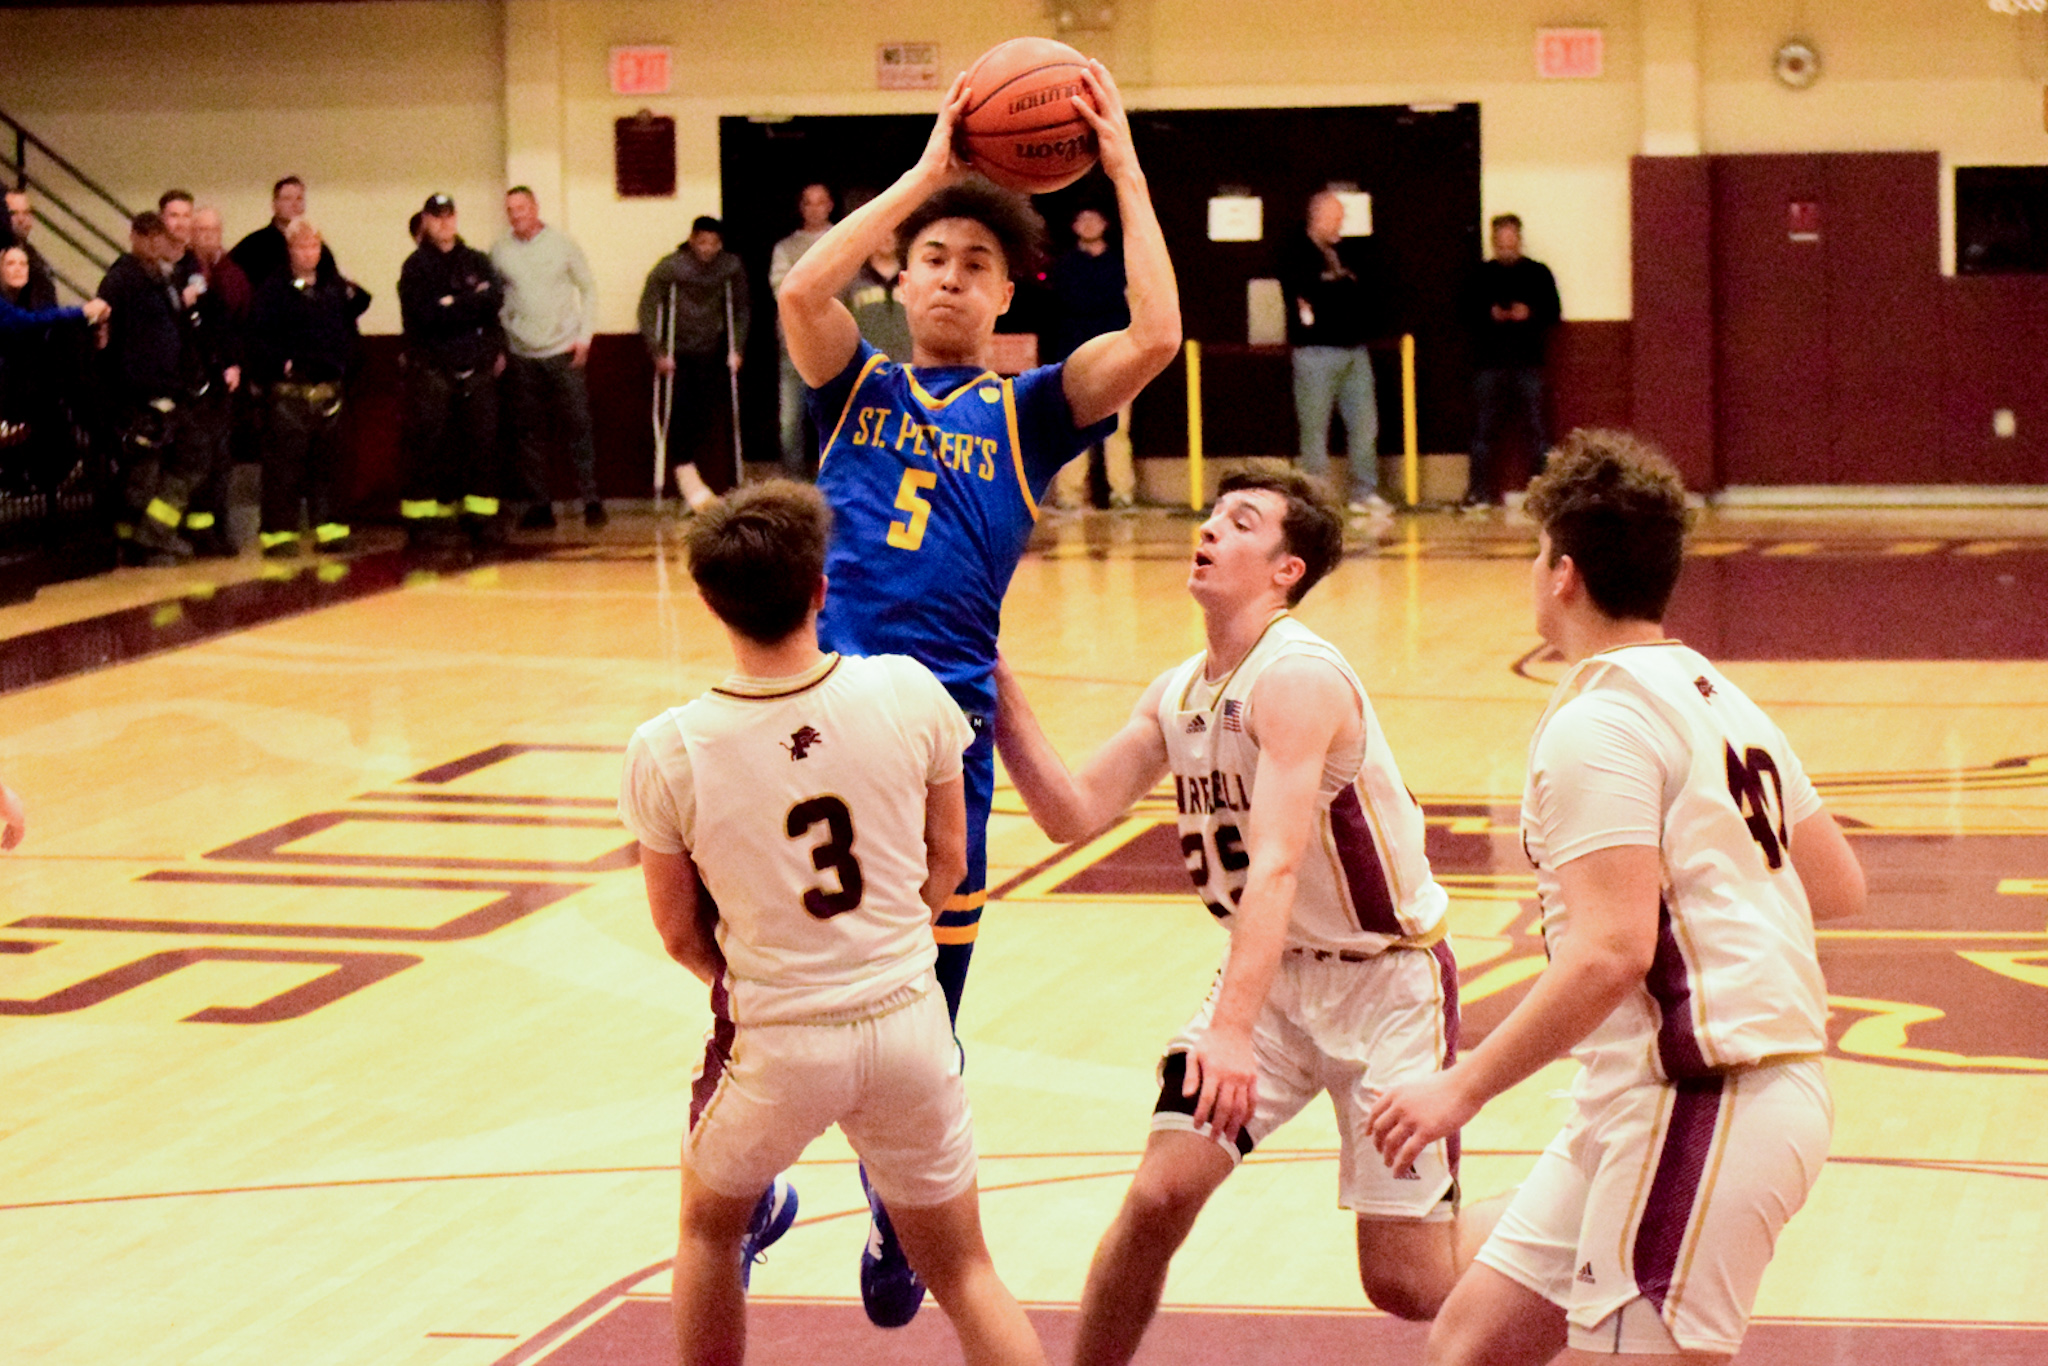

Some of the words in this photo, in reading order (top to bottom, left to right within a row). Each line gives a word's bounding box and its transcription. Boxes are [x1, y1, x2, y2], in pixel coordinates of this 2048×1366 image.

[853, 406, 892, 449] ST.
[895, 411, 998, 482] PETER'S
[886, 467, 938, 551] 5
[1722, 735, 1789, 873] 40
[784, 794, 864, 921] 3
